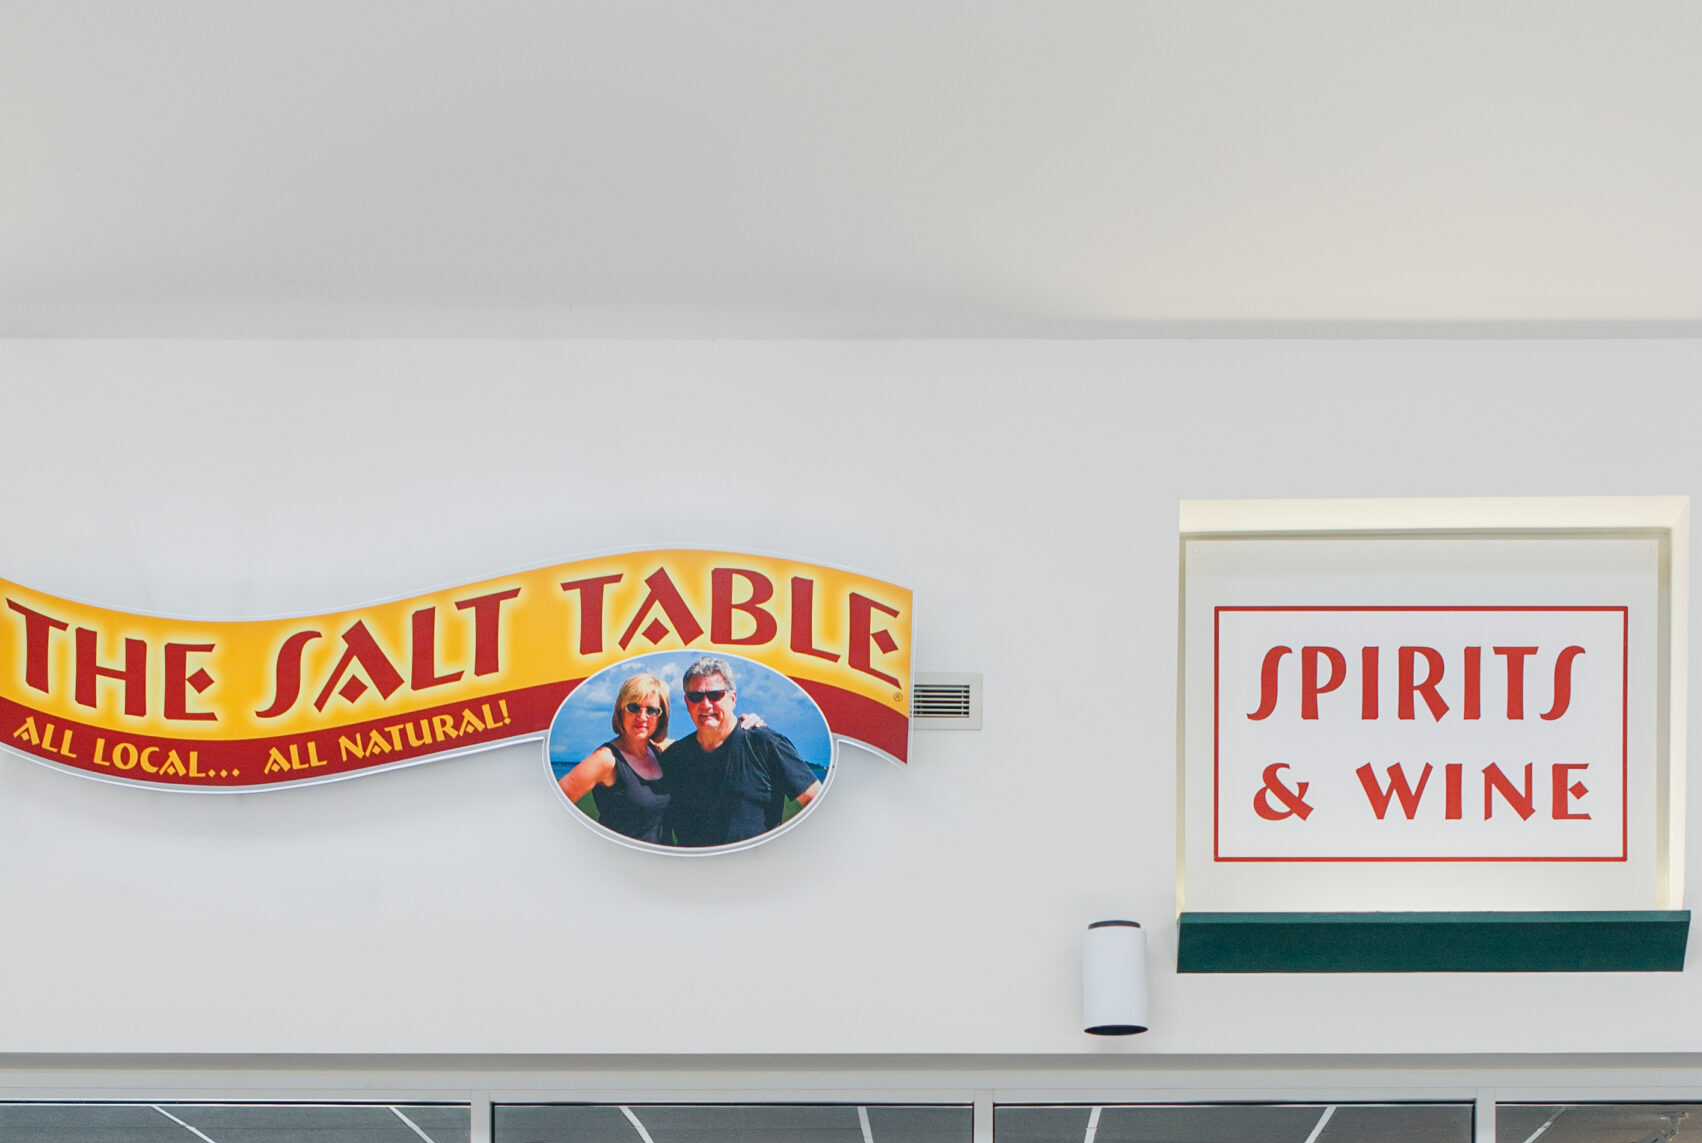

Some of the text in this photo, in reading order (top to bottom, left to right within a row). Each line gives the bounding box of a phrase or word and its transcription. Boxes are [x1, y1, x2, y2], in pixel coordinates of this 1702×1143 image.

[6, 566, 902, 721] THE SALT TABLE
[1246, 645, 1586, 723] SPIRITS
[13, 699, 511, 778] ALL LOCAL... ALL NATURAL!
[1253, 762, 1592, 822] & WINE
